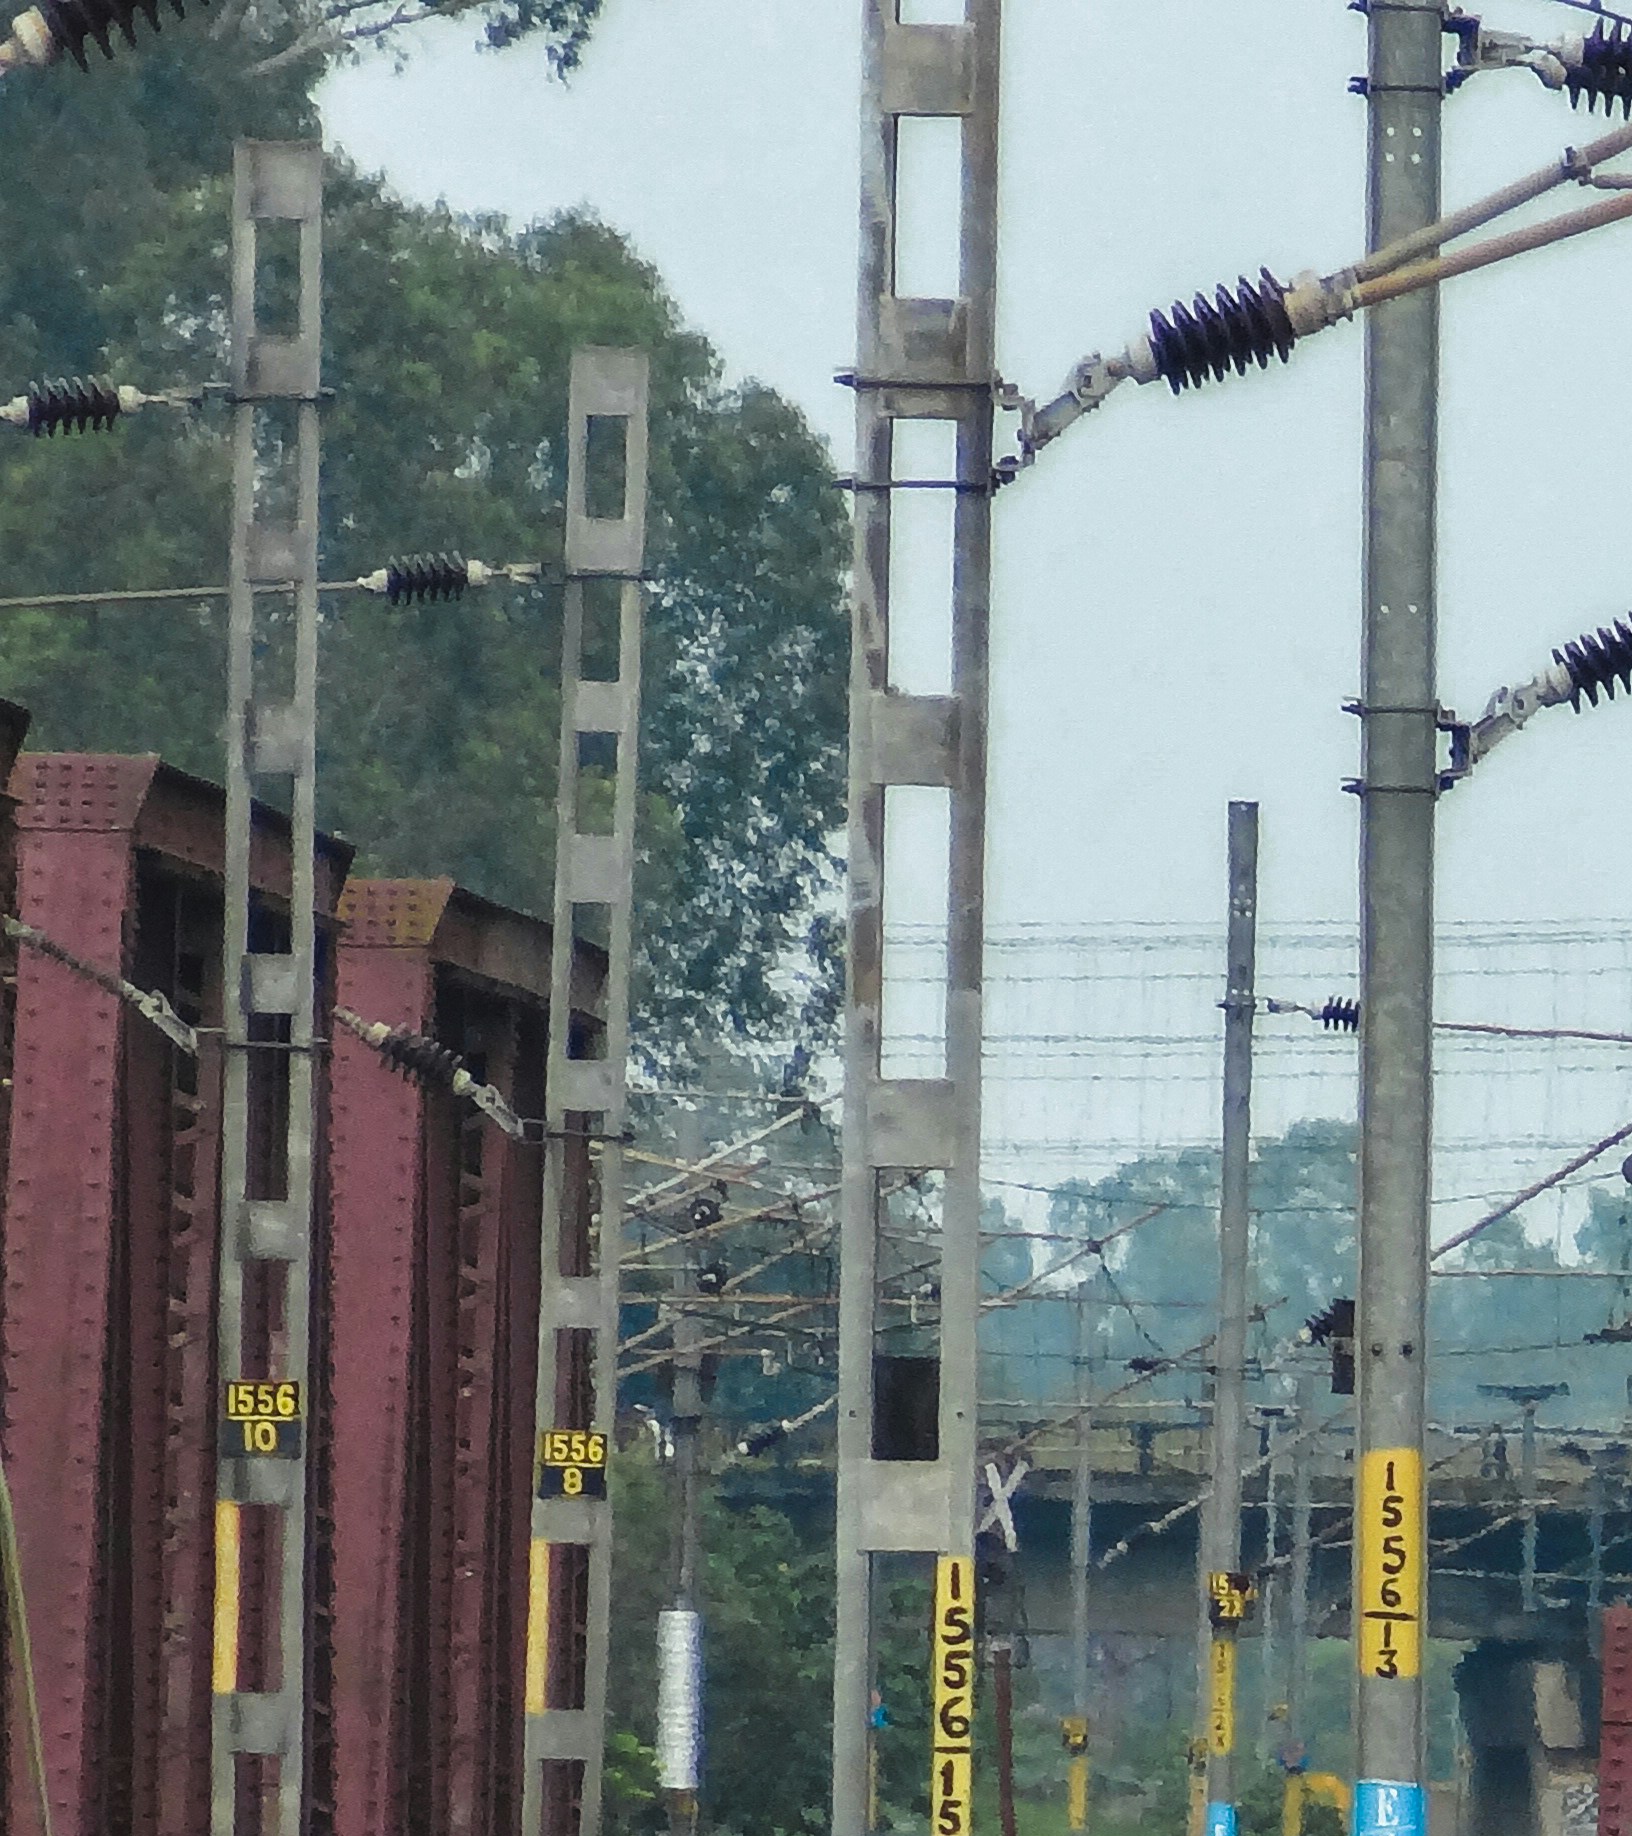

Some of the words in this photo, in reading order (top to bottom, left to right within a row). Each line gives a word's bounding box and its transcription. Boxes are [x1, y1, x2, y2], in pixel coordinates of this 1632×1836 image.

[228, 1382, 296, 1416] 1556
[243, 1421, 278, 1452] 10
[543, 1431, 605, 1463] 1556
[562, 1467, 583, 1495] 8
